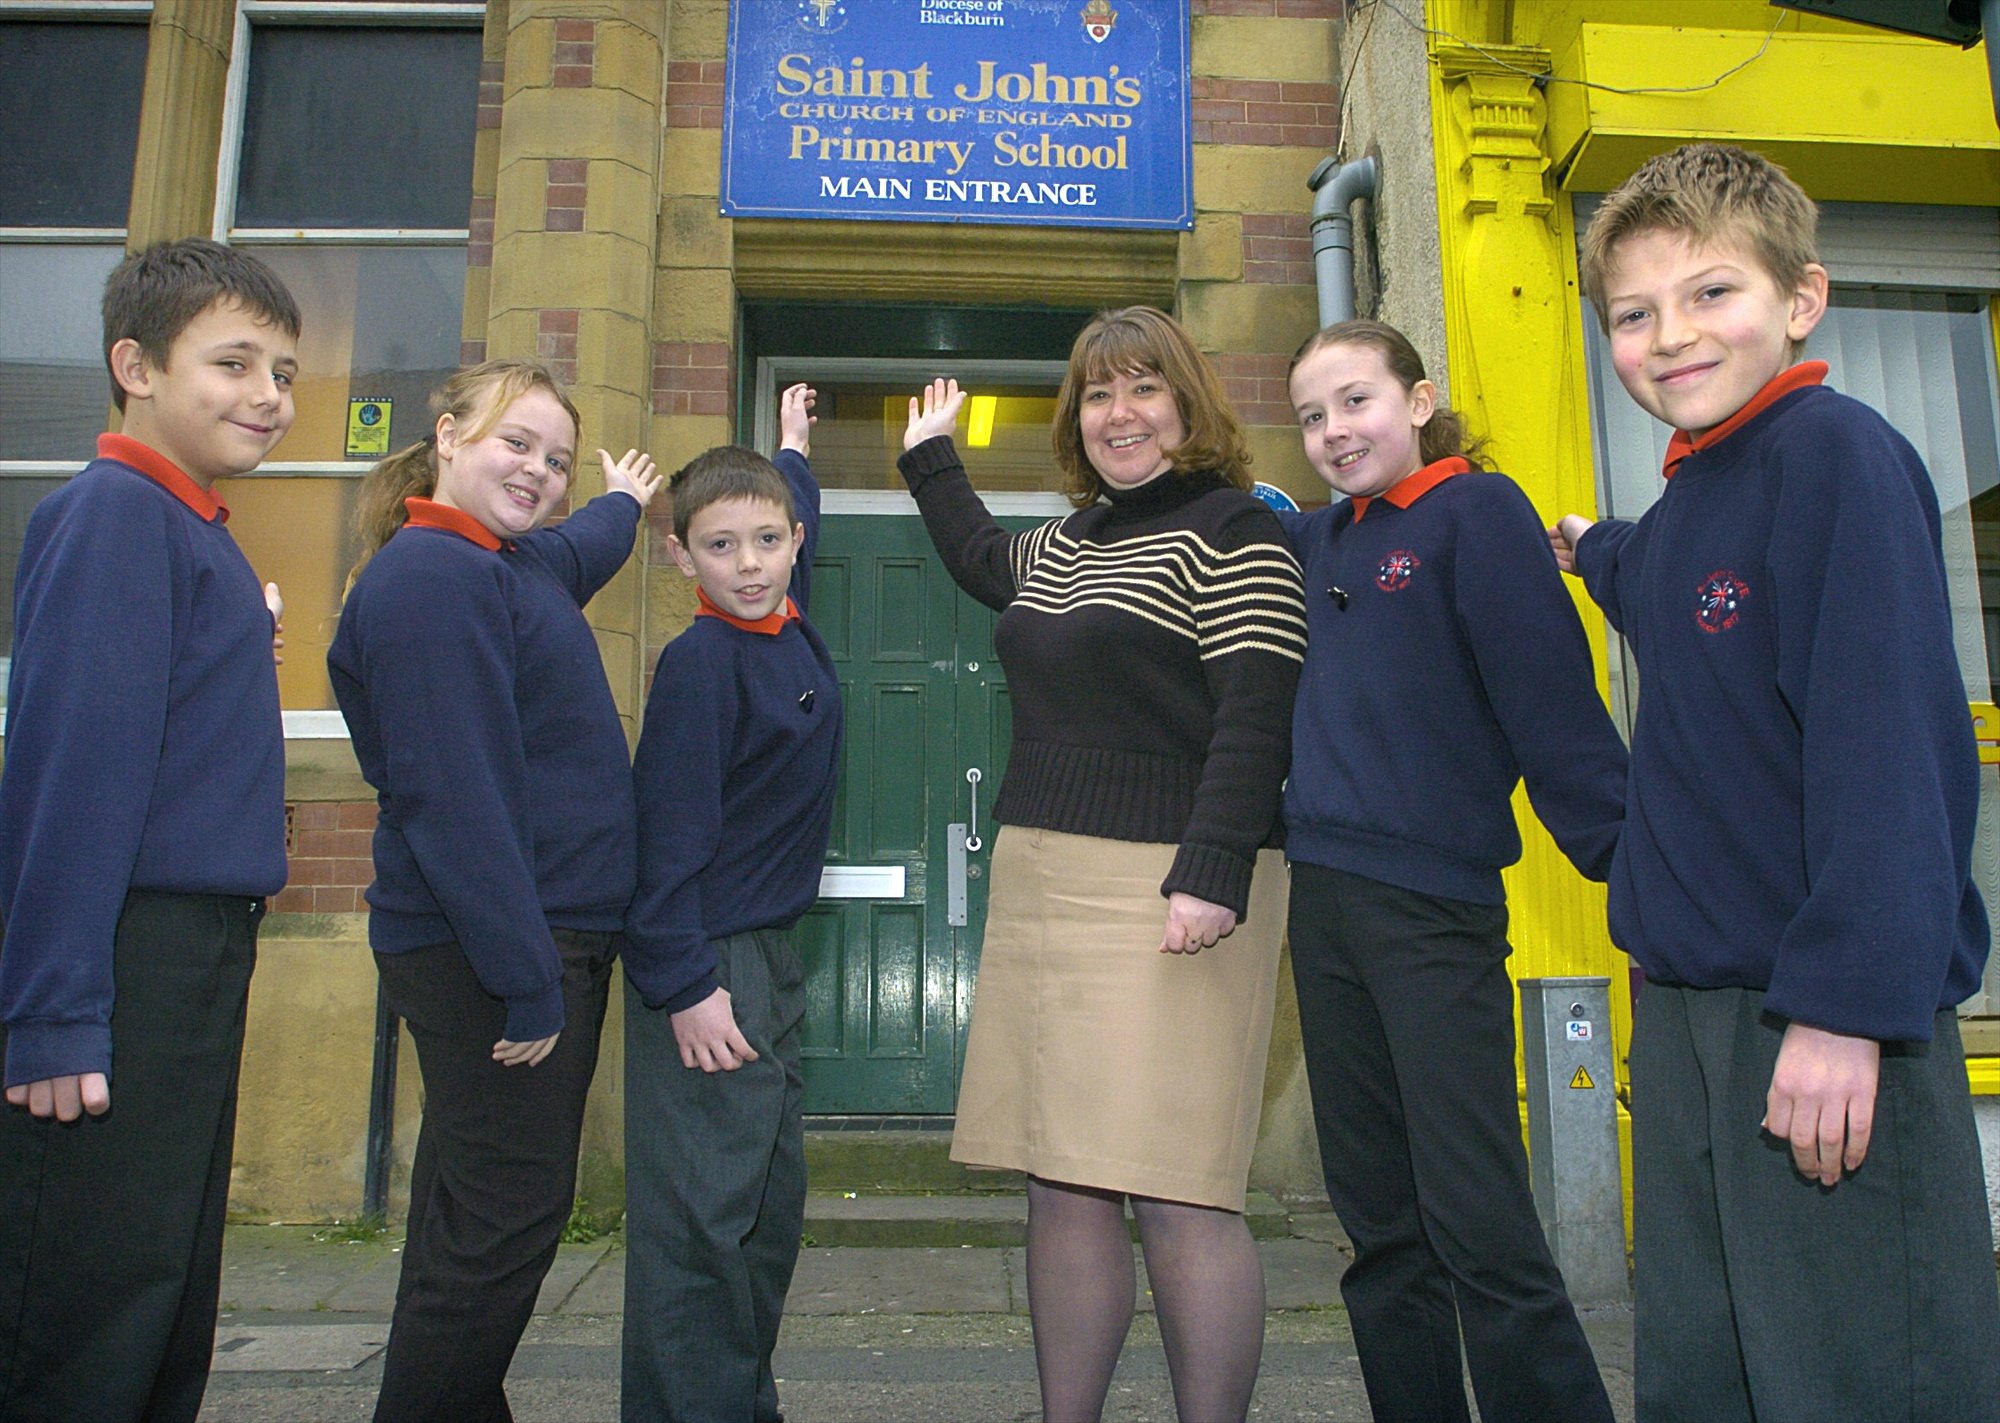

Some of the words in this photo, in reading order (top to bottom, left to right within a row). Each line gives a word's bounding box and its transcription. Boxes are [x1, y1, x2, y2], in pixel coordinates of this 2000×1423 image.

[920, 9, 1005, 26] Blackburn
[921, 0, 984, 11] Diocese
[987, 0, 1004, 12] of
[776, 53, 934, 99] Saint
[954, 60, 1142, 108] John's
[779, 102, 914, 122] CHURCH
[926, 107, 966, 122] OF
[978, 109, 1133, 128] ENGLAND
[788, 124, 976, 175] Primary
[994, 131, 1129, 170] School
[820, 176, 912, 200] MAIN
[925, 179, 1098, 206] ENTRANCE
